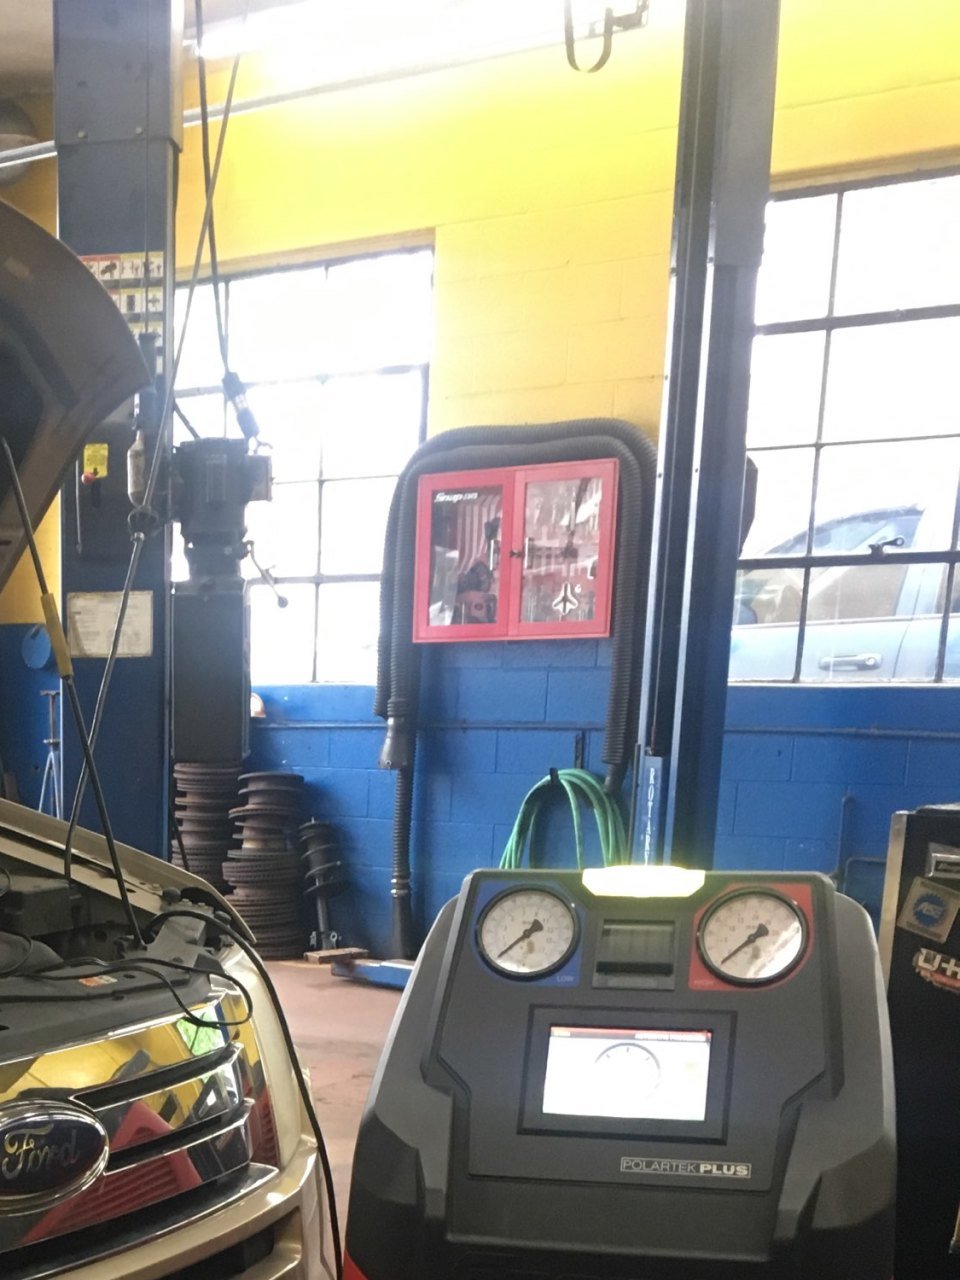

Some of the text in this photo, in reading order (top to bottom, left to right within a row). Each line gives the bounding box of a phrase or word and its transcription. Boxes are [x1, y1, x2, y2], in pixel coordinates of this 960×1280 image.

[2, 1123, 79, 1179] Ford
[623, 1160, 748, 1175] POLARTEK PLUS
